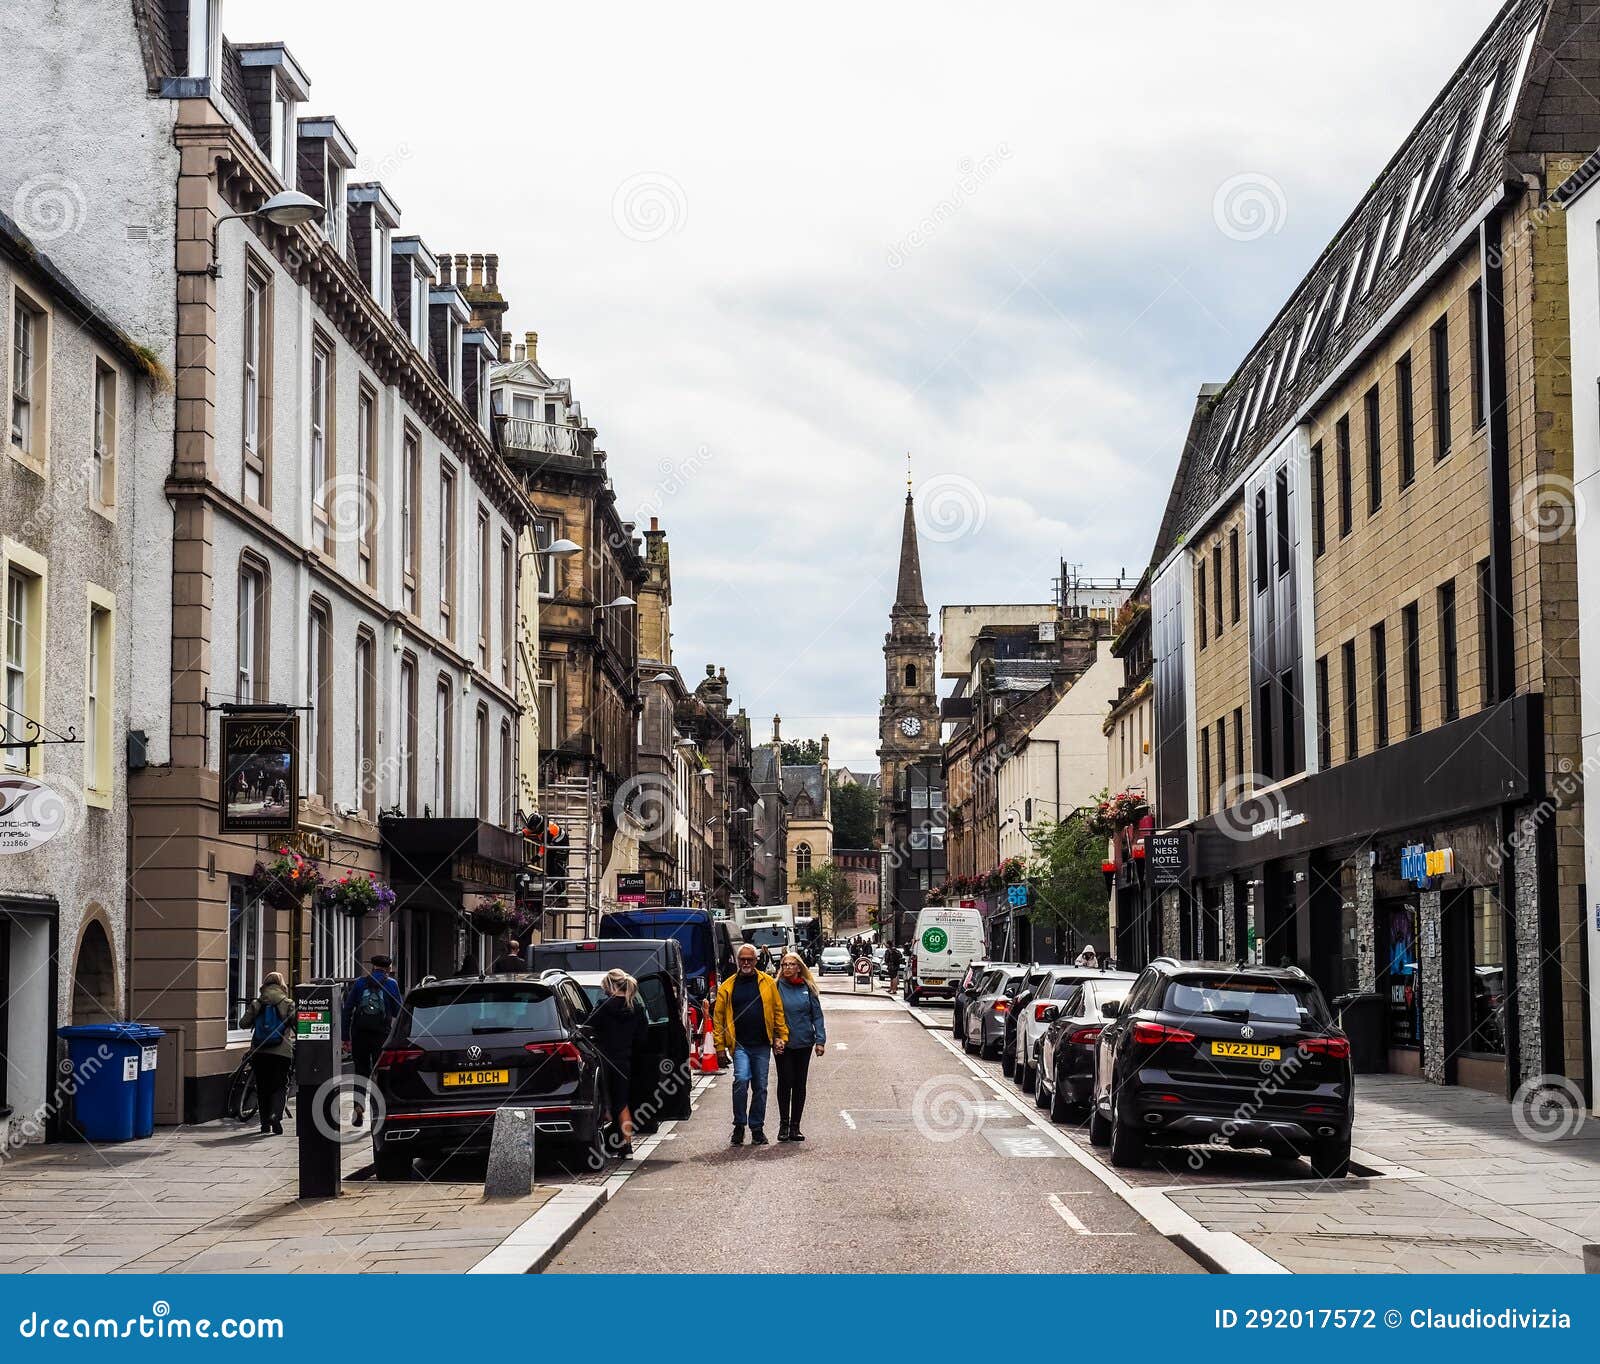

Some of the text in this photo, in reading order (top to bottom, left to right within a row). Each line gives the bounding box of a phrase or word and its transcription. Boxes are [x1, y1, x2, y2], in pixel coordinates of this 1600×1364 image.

[1152, 837, 1180, 846] RIVER
[1155, 846, 1178, 855] NESS
[1152, 856, 1182, 864] HOTEL
[929, 935, 941, 943] 60
[1216, 1043, 1275, 1057] SY22 UJP
[458, 1071, 500, 1084] M4 OCH
